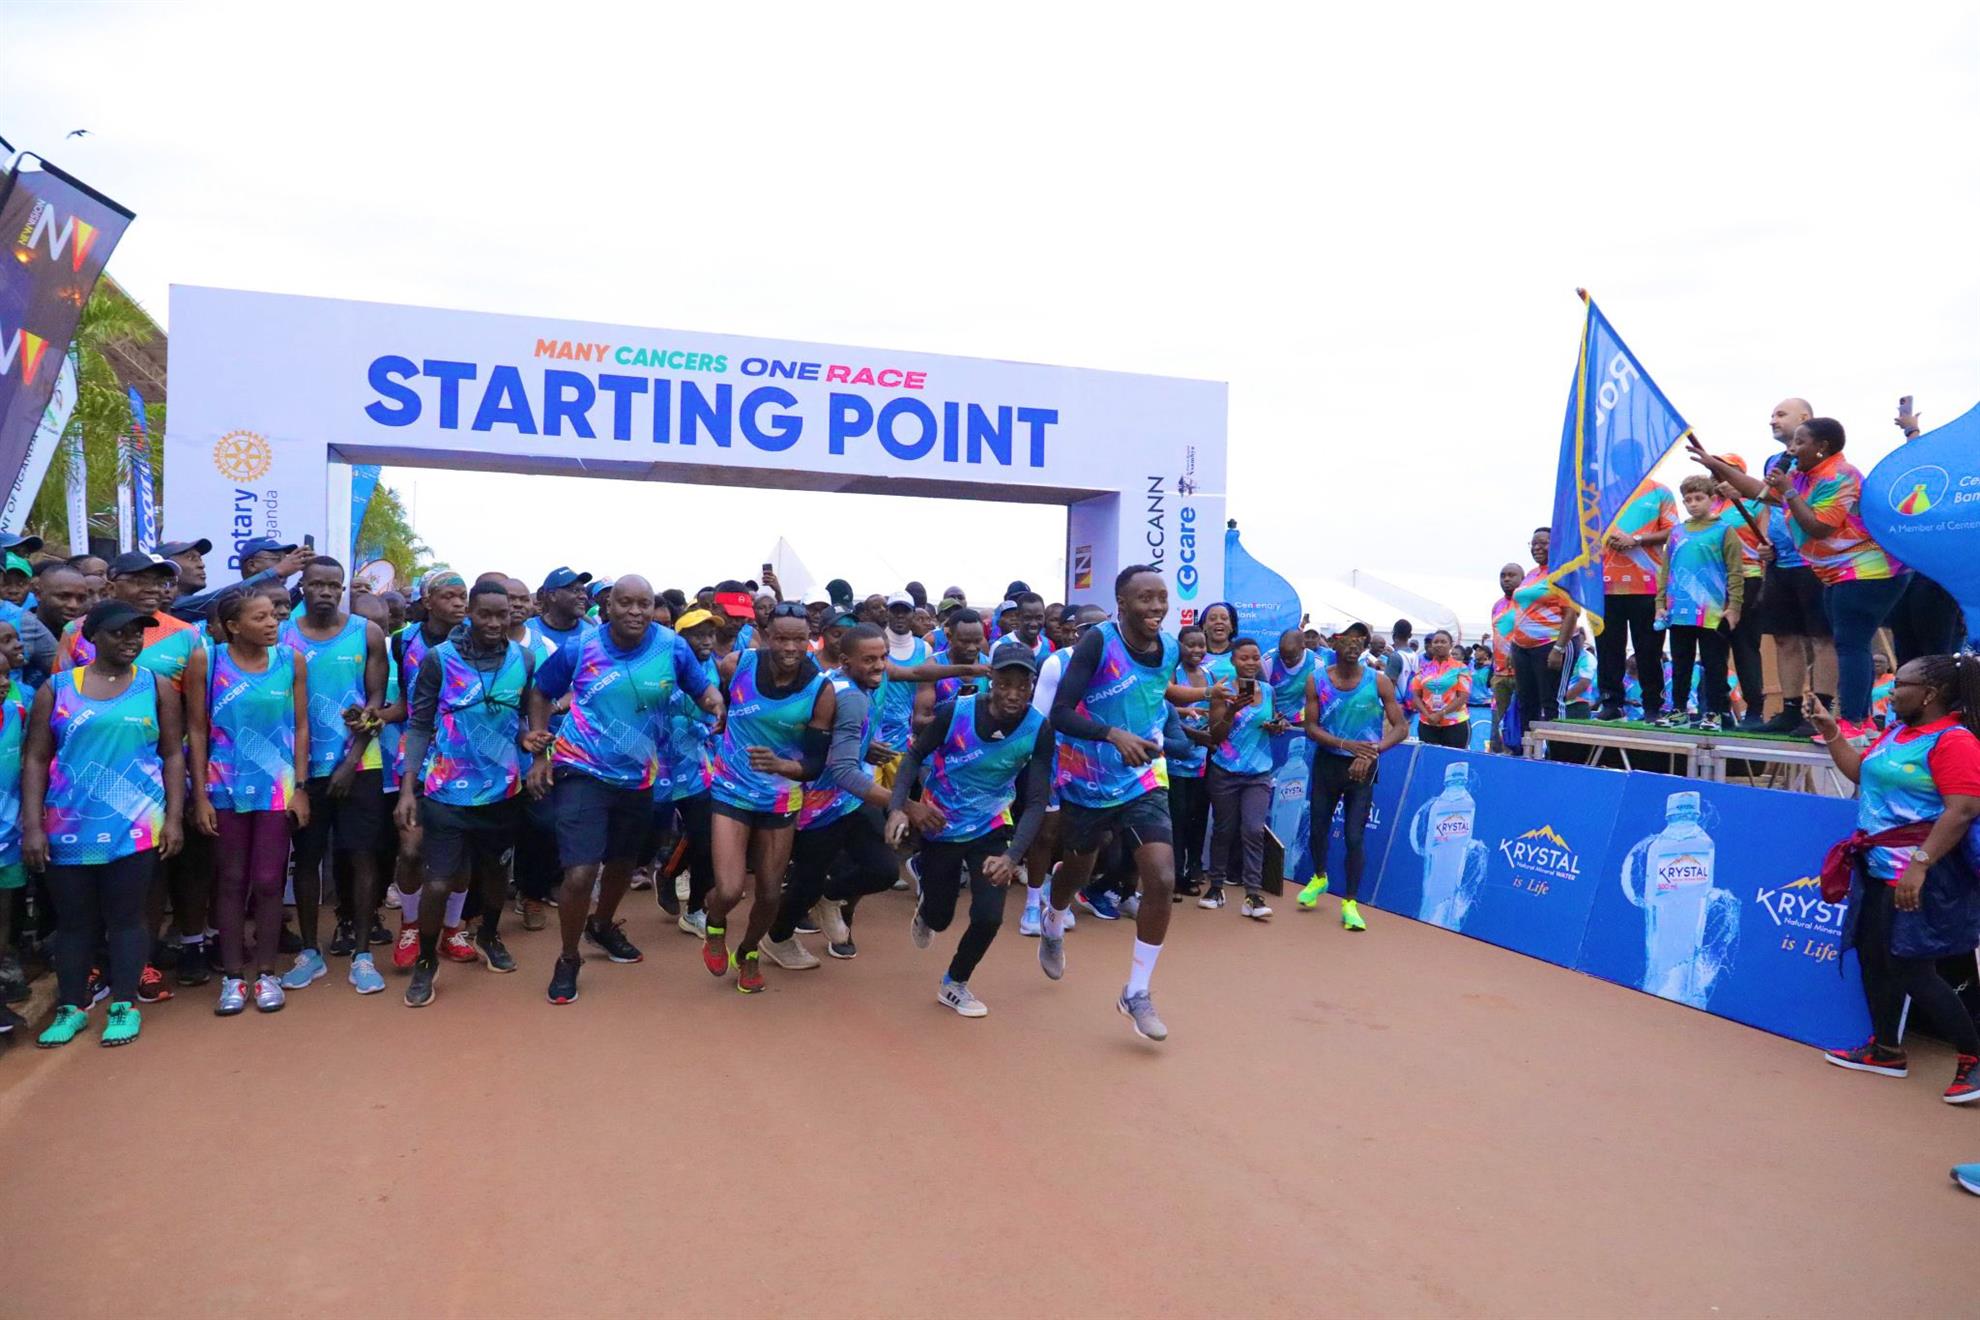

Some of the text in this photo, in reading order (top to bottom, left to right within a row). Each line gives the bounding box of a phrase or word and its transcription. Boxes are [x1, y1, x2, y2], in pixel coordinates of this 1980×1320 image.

[534, 339, 928, 389] MANY CANCERS ONE RACE
[364, 355, 1059, 467] STARTING POINT
[263, 490, 281, 540] ganda
[213, 681, 250, 717] ANCER
[1087, 674, 1137, 704] CANCER
[1499, 838, 1580, 874] KRYSTAL
[1527, 878, 1549, 896] Life
[1659, 866, 1708, 883] KRYSTAL
[1756, 887, 1849, 927] KRYST
[1784, 917, 1842, 937] Natural Minera
[1781, 934, 1838, 963] is Life
